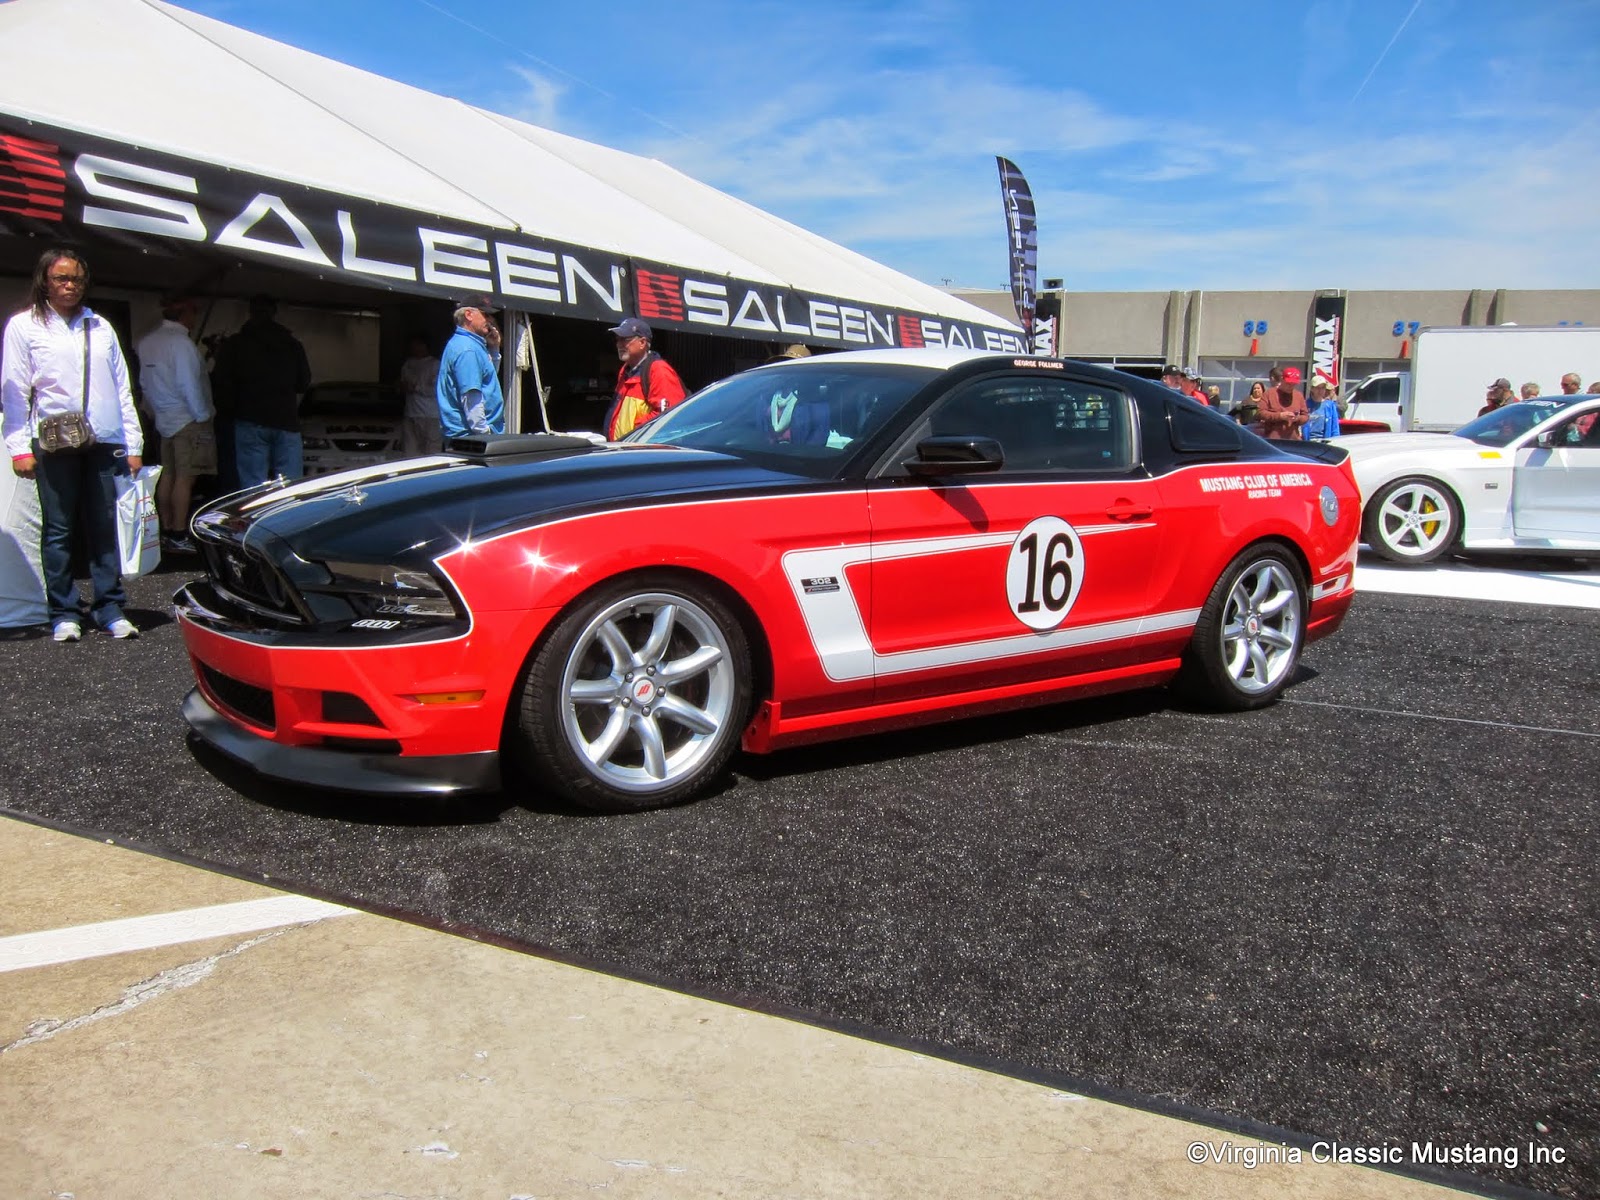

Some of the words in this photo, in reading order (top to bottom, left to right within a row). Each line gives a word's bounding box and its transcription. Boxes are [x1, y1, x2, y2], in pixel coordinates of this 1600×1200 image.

[74, 153, 623, 312] SALEEN
[684, 279, 894, 345] SALEEN
[1243, 319, 1268, 336] 38
[1393, 320, 1420, 336] 37
[1014, 359, 1037, 368] GEORGE
[1038, 361, 1064, 370] FOLLMER
[1200, 476, 1245, 492] MUSTANG
[1243, 475, 1267, 489] CLUB
[1266, 474, 1280, 487] OF
[1279, 473, 1313, 487] AMERICA
[1248, 489, 1268, 499] RACING
[1268, 488, 1282, 497] TEAM
[1018, 532, 1074, 613] 16
[811, 577, 832, 586] 302
